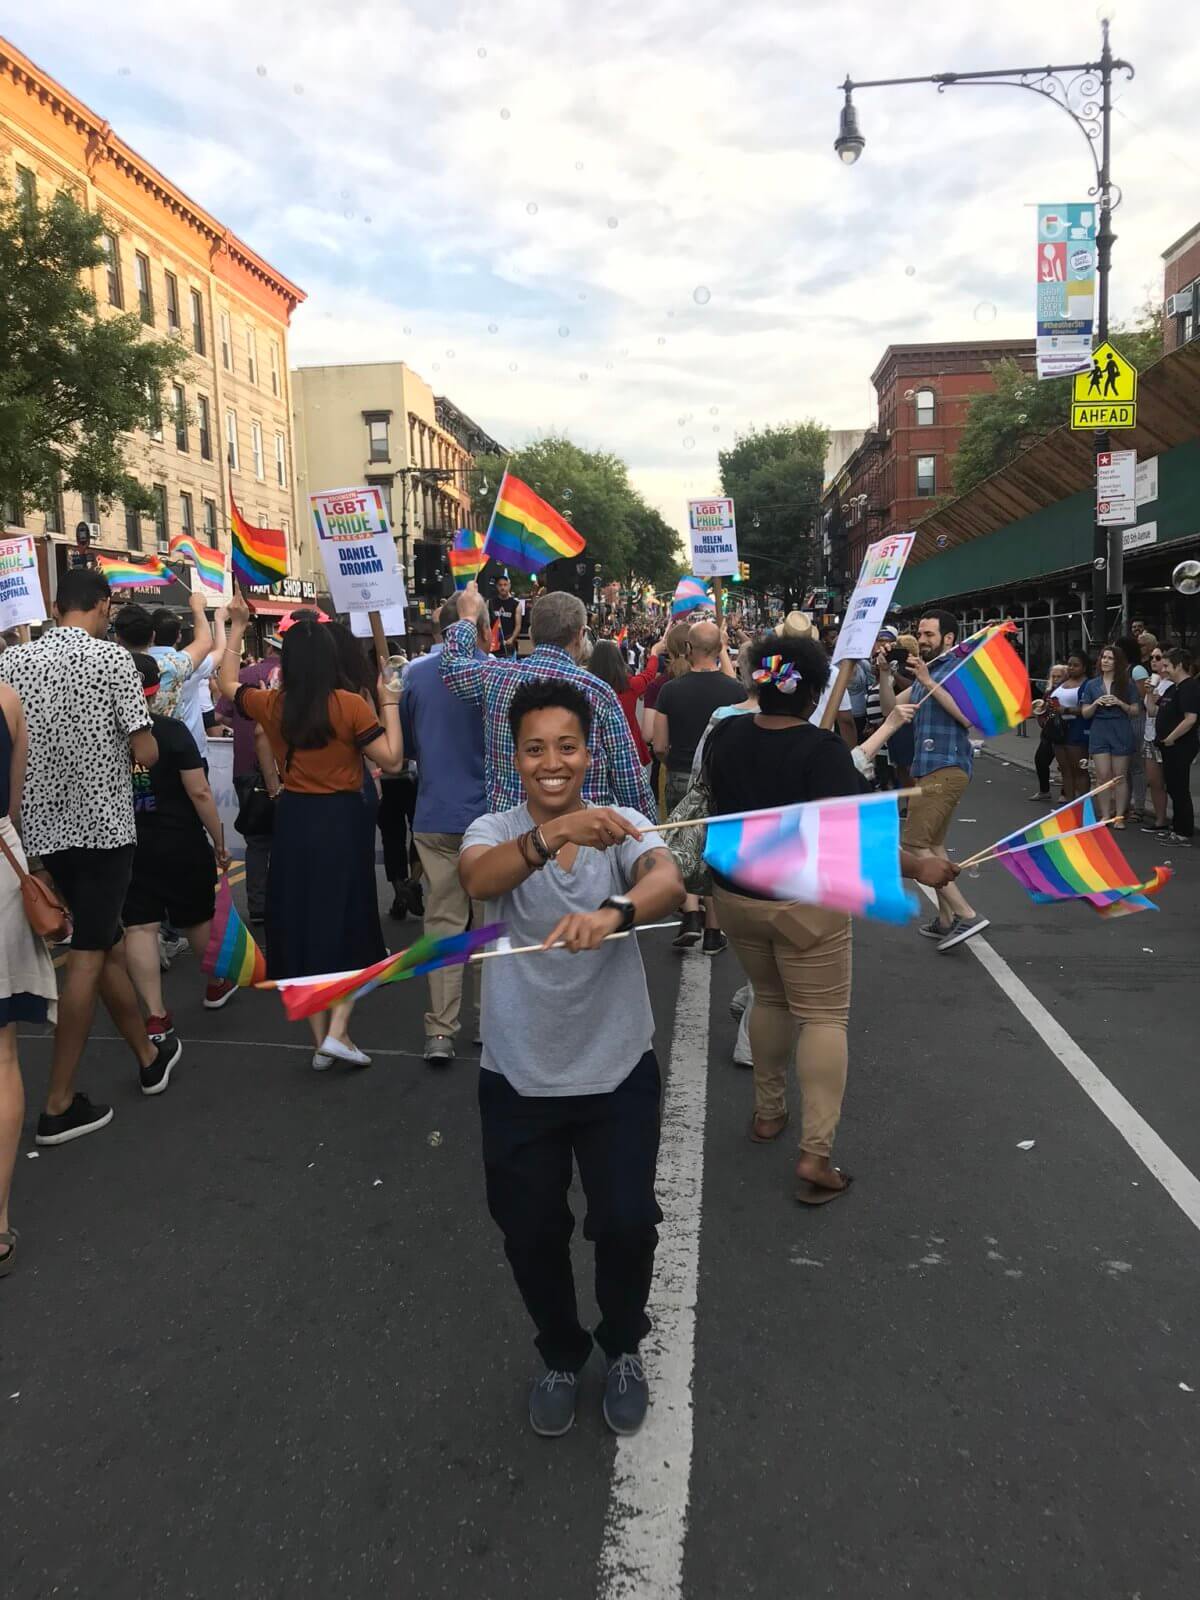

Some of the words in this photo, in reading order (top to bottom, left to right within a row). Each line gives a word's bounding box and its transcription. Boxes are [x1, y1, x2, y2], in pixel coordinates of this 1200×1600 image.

[1079, 408, 1129, 423] AHEAD
[323, 499, 367, 516] LGBT
[696, 506, 723, 515] LGBT
[327, 513, 372, 535] PRIDE
[696, 515, 724, 527] PRIDE
[702, 535, 722, 545] HELEN
[338, 545, 377, 561] DANIEL
[694, 543, 733, 554] ROSENTHAL
[339, 559, 383, 576] DROMM
[283, 579, 301, 597] SHOP
